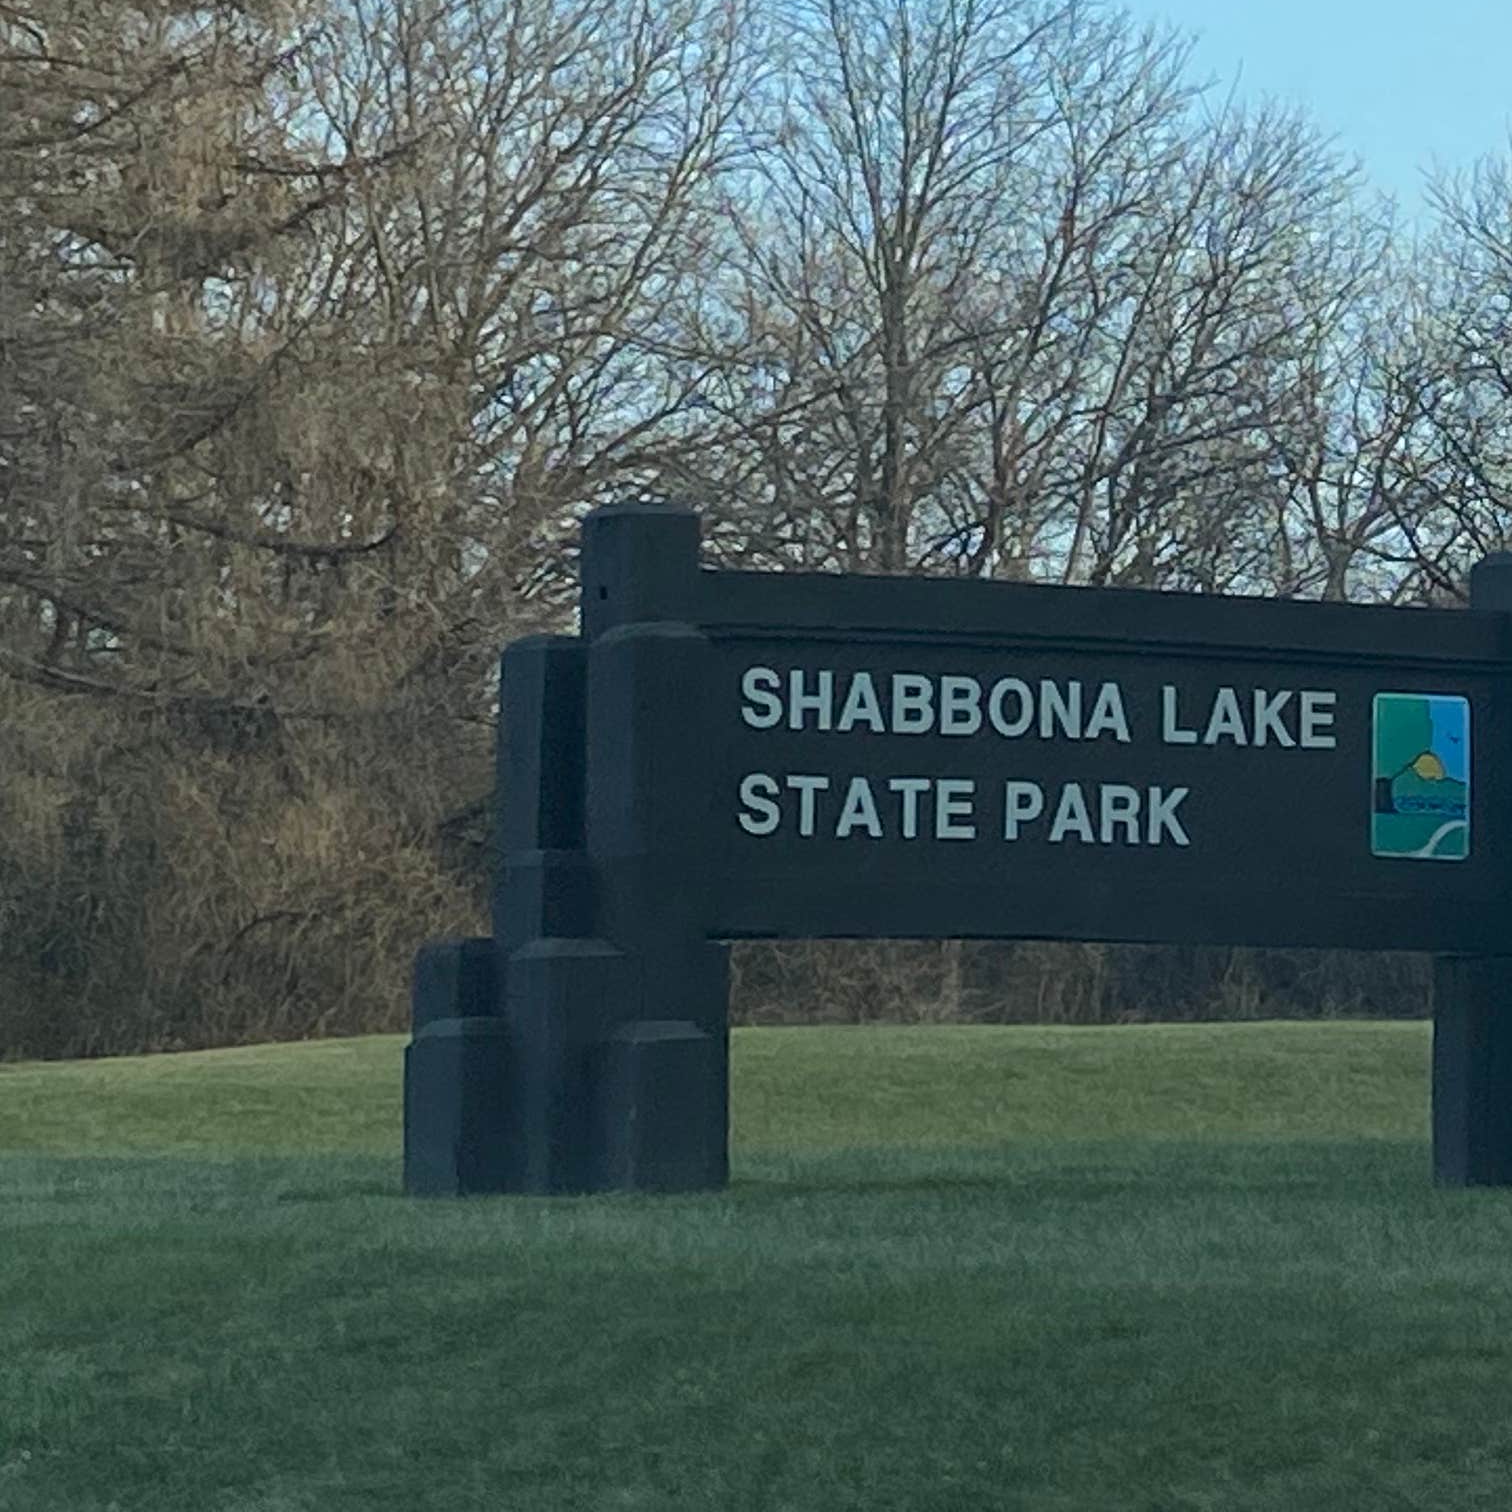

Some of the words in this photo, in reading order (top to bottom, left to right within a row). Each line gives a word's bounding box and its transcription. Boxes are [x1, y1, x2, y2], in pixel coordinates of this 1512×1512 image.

[740, 667, 1131, 744] SHABBONA
[1163, 685, 1337, 749] LAKE
[739, 773, 976, 840] STATE
[1005, 781, 1191, 846] PARK
